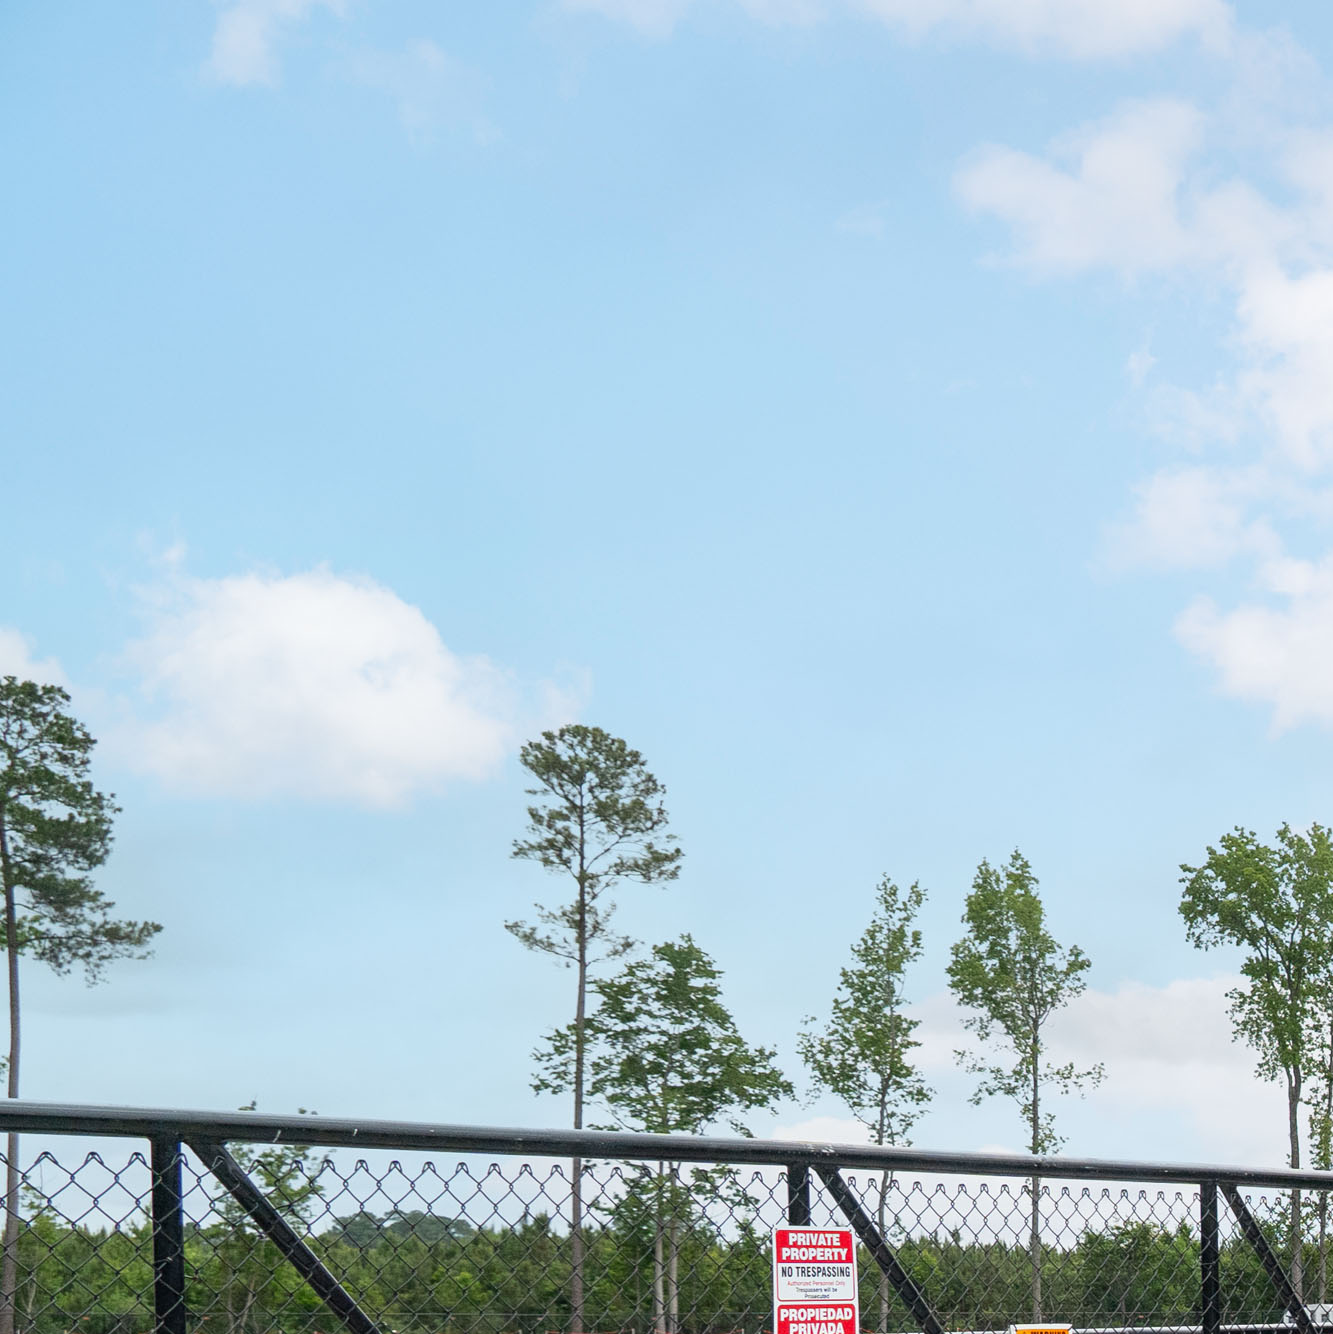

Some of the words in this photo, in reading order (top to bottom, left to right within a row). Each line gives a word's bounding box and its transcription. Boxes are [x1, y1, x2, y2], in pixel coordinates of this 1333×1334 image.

[788, 1233, 840, 1246] PRIVATE
[781, 1248, 848, 1261] PROPERTY
[781, 1266, 793, 1278] NO
[796, 1266, 850, 1278] TRESPASSING
[780, 1307, 853, 1322] PROPIEDAD
